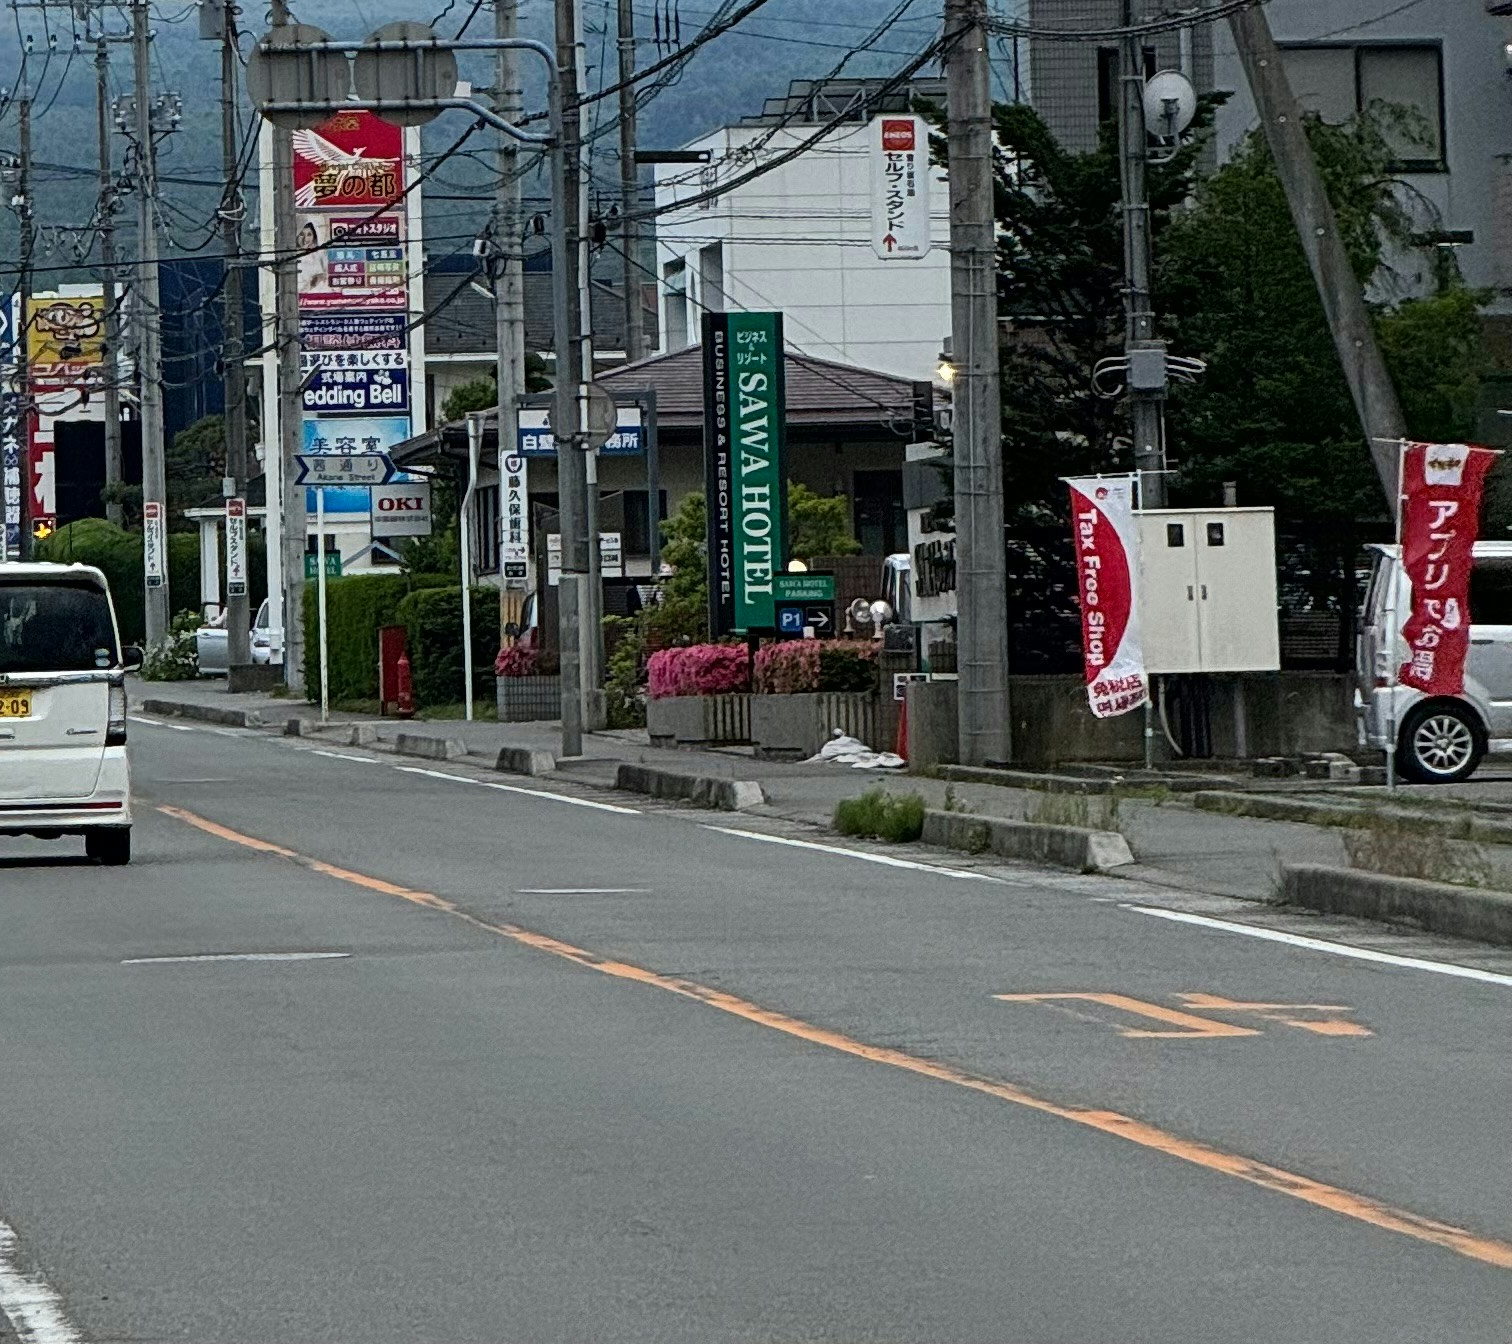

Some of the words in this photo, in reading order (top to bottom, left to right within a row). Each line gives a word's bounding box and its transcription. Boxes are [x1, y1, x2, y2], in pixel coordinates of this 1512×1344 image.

[312, 172, 398, 200] 夢の都
[736, 330, 768, 344] ビジネス
[736, 352, 768, 365] リゾート
[369, 383, 402, 404] Bell
[715, 330, 727, 429] BUSINESS
[738, 372, 770, 477] SAWA
[309, 435, 384, 455] 美容室
[349, 473, 376, 481] Street
[717, 452, 729, 533] RESORT
[378, 497, 424, 511] OKI
[742, 484, 773, 605] HOTEL
[1078, 508, 1098, 551] Tax
[720, 539, 731, 605] HOTEL
[1083, 556, 1102, 607] Free
[782, 613, 802, 627] P1
[1087, 611, 1106, 667] Shop
